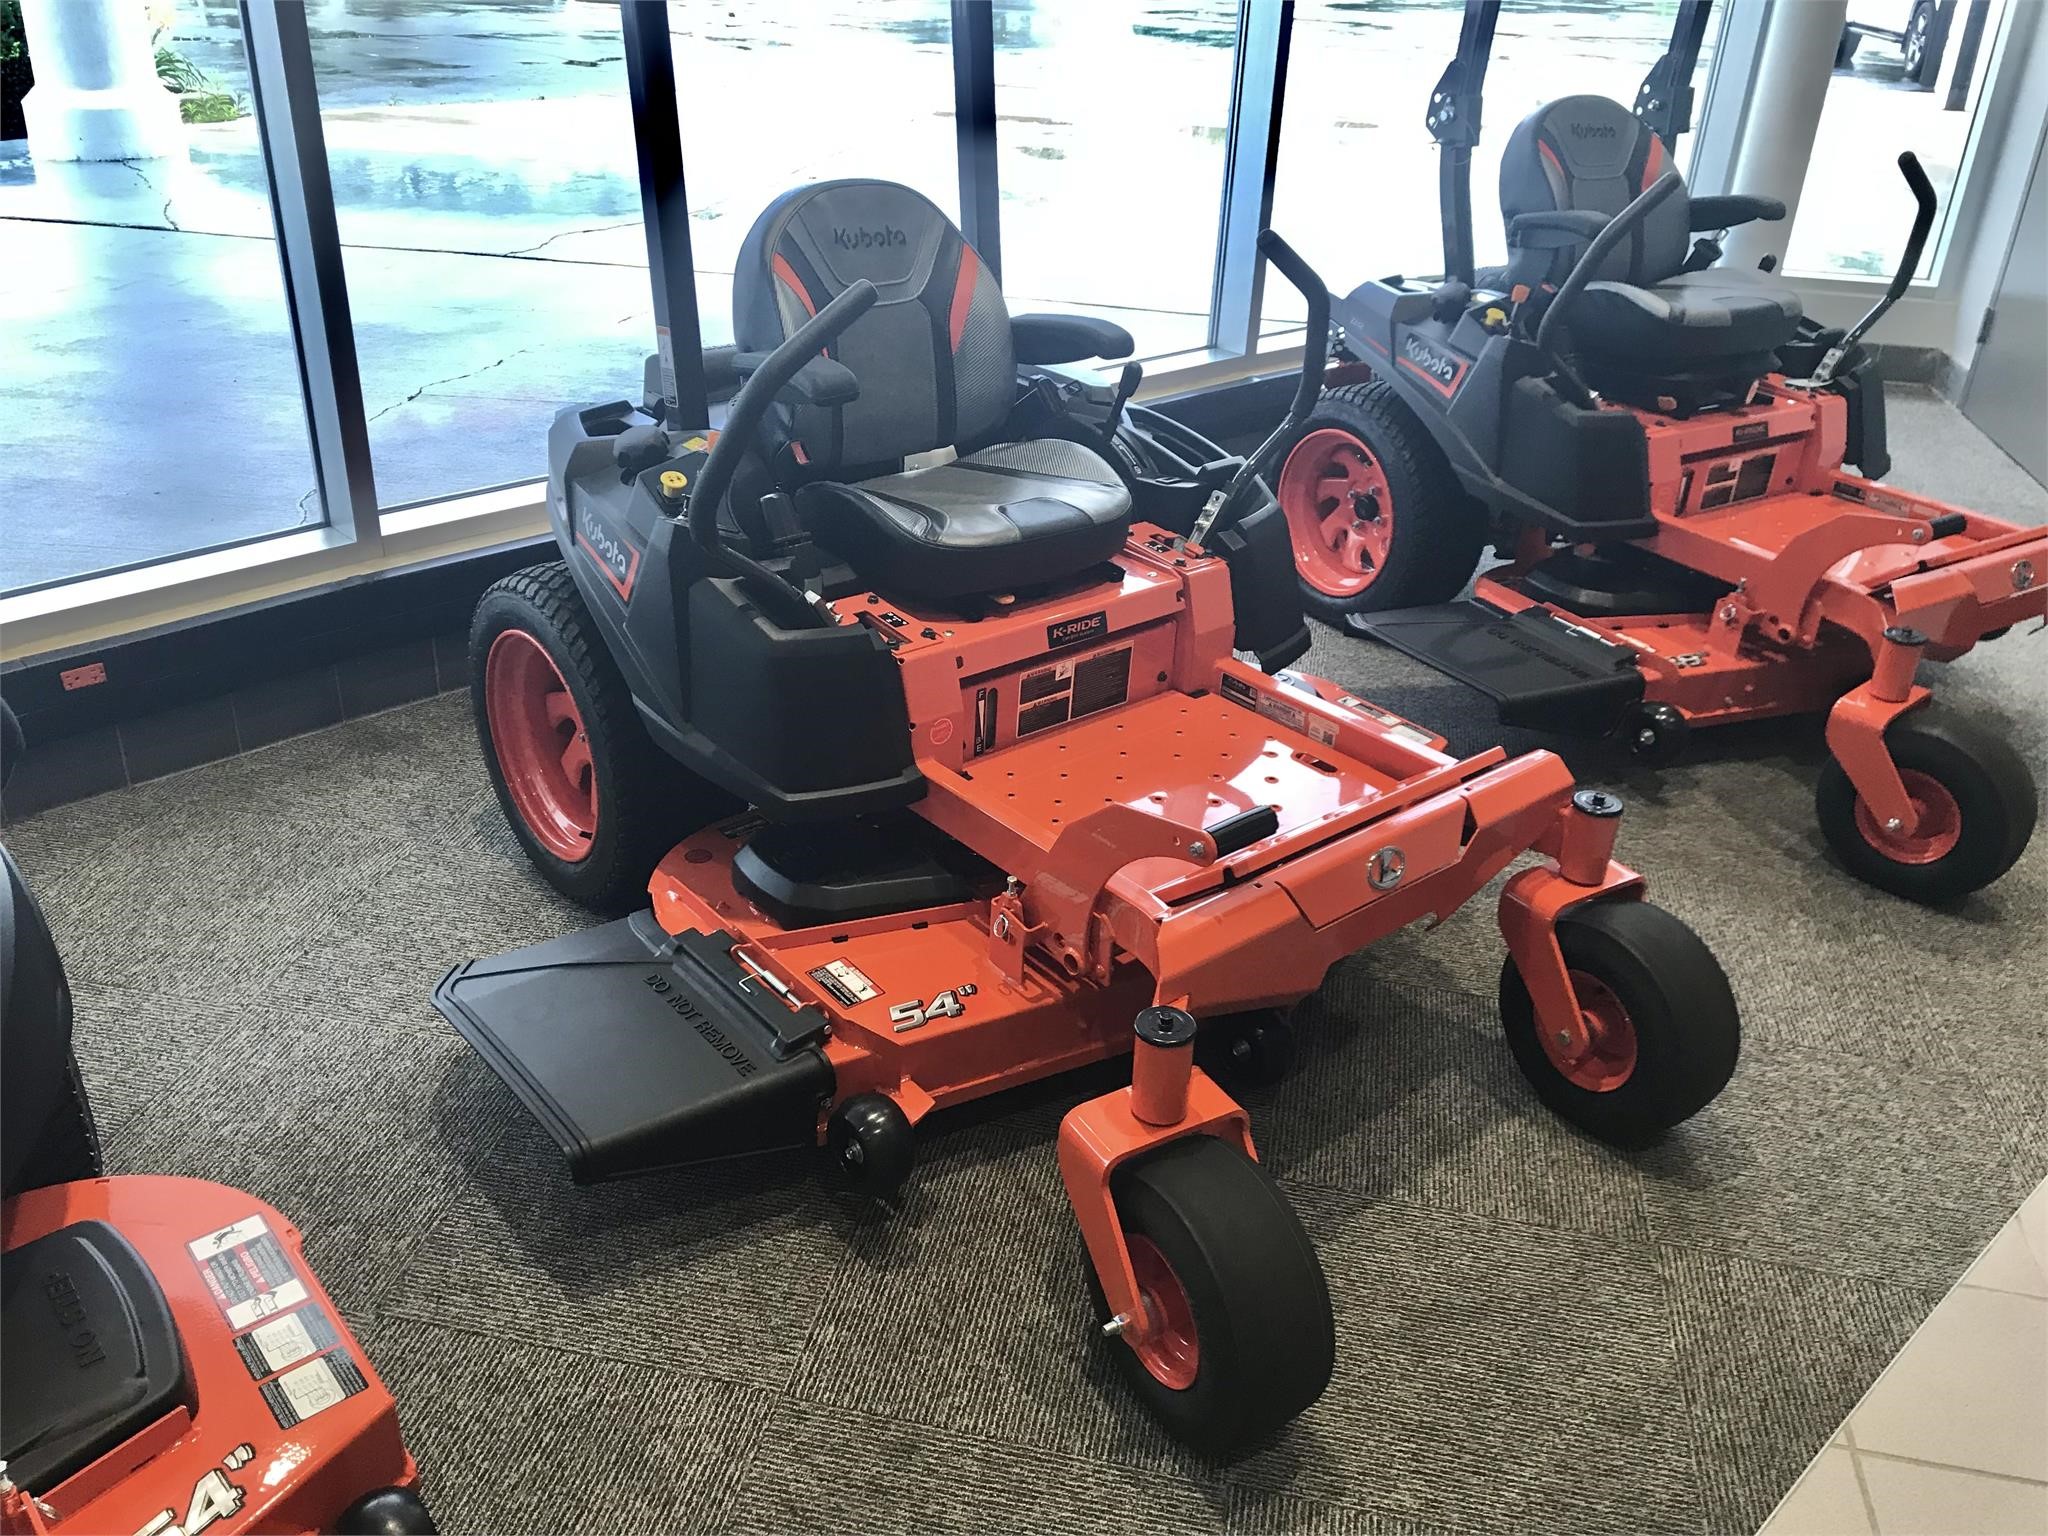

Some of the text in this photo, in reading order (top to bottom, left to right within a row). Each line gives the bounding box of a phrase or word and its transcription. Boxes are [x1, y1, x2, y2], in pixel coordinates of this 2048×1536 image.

[833, 225, 907, 250] Kubota
[1405, 337, 1453, 381] Kubota
[582, 506, 626, 575] Kubota
[1053, 615, 1102, 639] K-RIDE
[642, 973, 757, 1078] DO NOT REMOVE
[889, 984, 977, 1033] 54"
[202, 1267, 222, 1296] DANGER
[240, 1251, 261, 1280] PELIGRO
